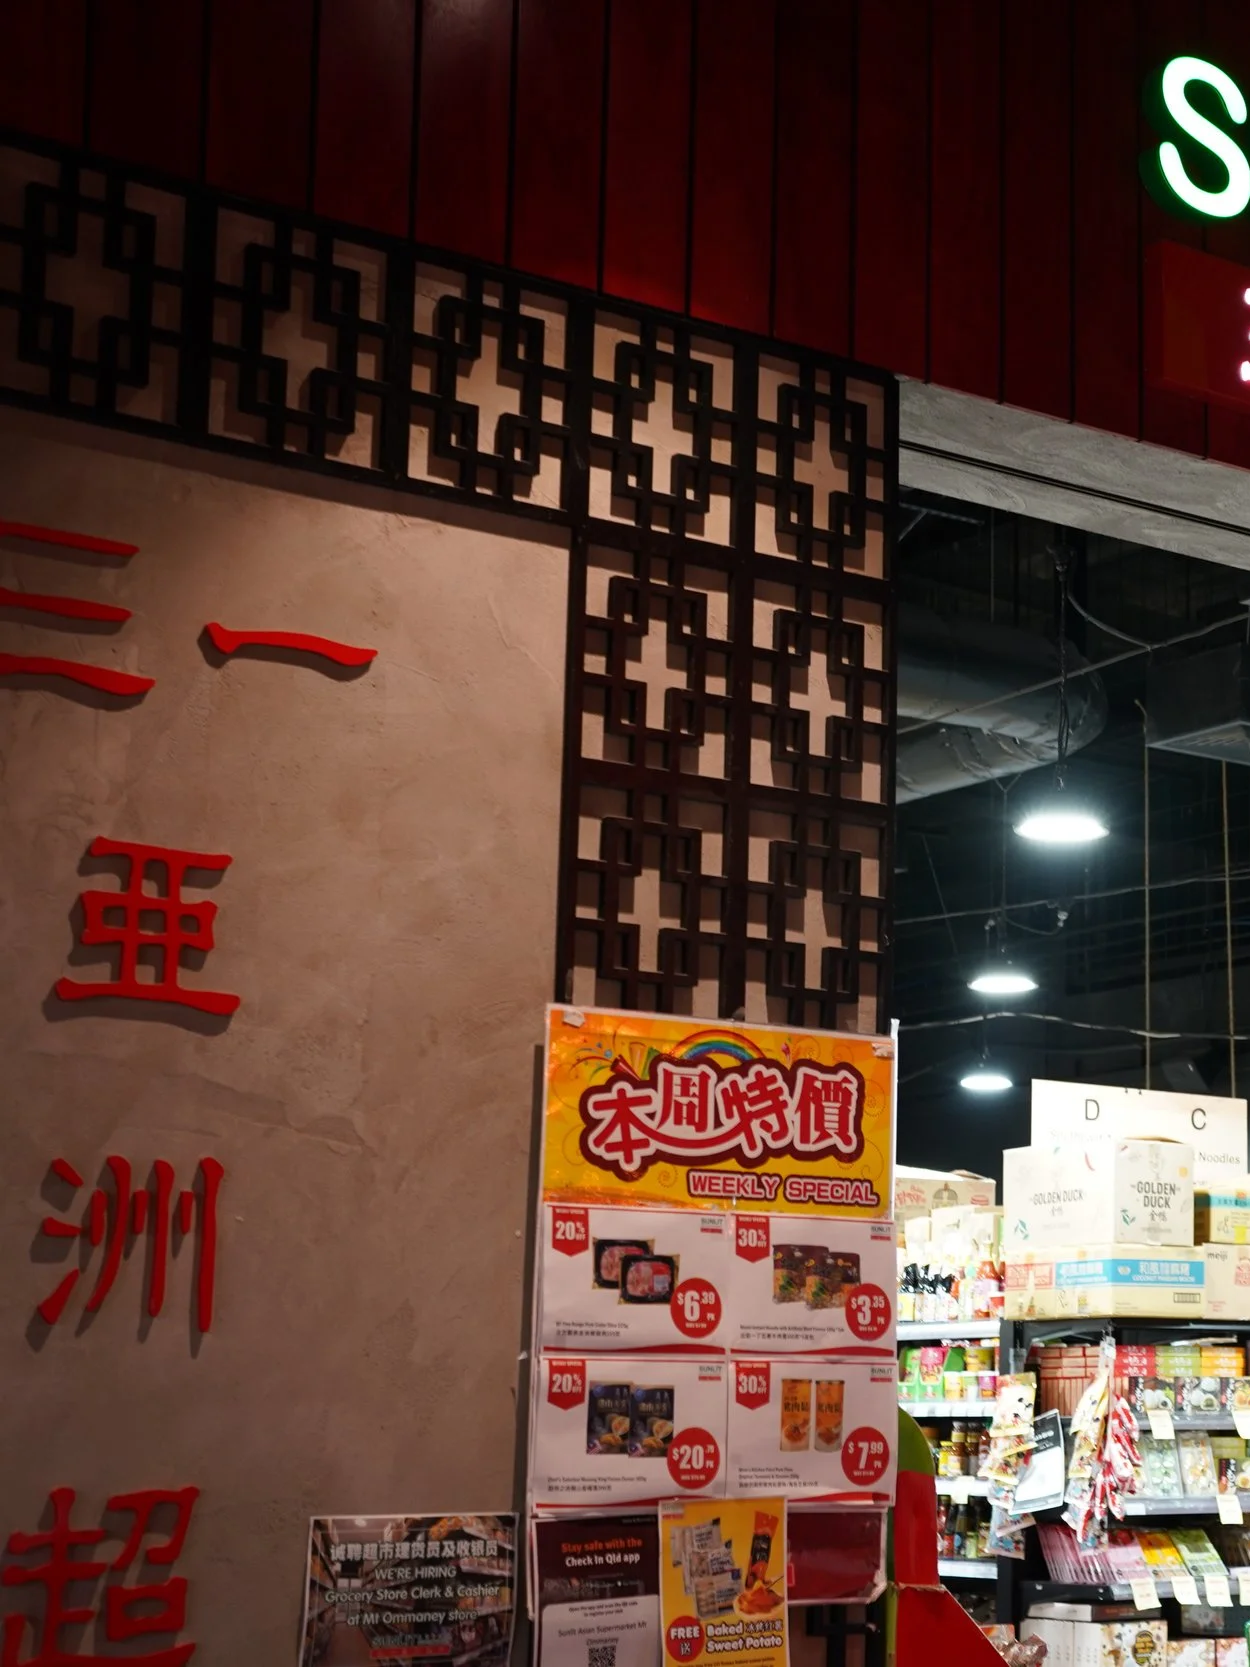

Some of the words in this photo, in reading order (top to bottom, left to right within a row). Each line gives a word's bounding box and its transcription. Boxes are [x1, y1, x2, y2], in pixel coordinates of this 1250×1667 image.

[589, 1062, 862, 1168] 本周特價
[1085, 1098, 1100, 1121] D
[1191, 1107, 1207, 1130] C
[1199, 1151, 1241, 1165] Noodles
[690, 1170, 780, 1200] WEEKLY
[787, 1176, 880, 1206] SPECIAL
[1137, 1180, 1176, 1196] GOLDEN
[1033, 1190, 1062, 1206] GOLDEN
[1062, 1189, 1084, 1203] DUCK
[1143, 1195, 1171, 1209] DUCK
[701, 1217, 723, 1226] SUNLIT
[1206, 1251, 1228, 1261] meiji
[870, 1367, 893, 1375] SUNLIT
[561, 1542, 582, 1554] Stay
[584, 1540, 604, 1551] safe
[605, 1538, 626, 1550] with
[627, 1537, 643, 1548] the
[565, 1555, 593, 1568] Check
[594, 1554, 604, 1565] In
[605, 1553, 622, 1565] Qld
[623, 1553, 641, 1565] app
[375, 1567, 412, 1581] WE'RE
[414, 1565, 457, 1580] HIRING
[325, 1590, 374, 1604] Grocery
[376, 1588, 408, 1602] Store
[411, 1587, 442, 1600] Clerk
[444, 1586, 454, 1598] &
[457, 1584, 500, 1597] Cashier
[347, 1614, 360, 1626] at
[363, 1613, 380, 1626] Mt
[382, 1610, 446, 1626] Ommaney
[448, 1608, 478, 1621] store
[597, 1623, 637, 1635] Supermarket
[670, 1626, 700, 1640] FREE
[706, 1621, 743, 1637] Baked
[706, 1638, 744, 1654] Sweet
[745, 1635, 783, 1650] Potato
